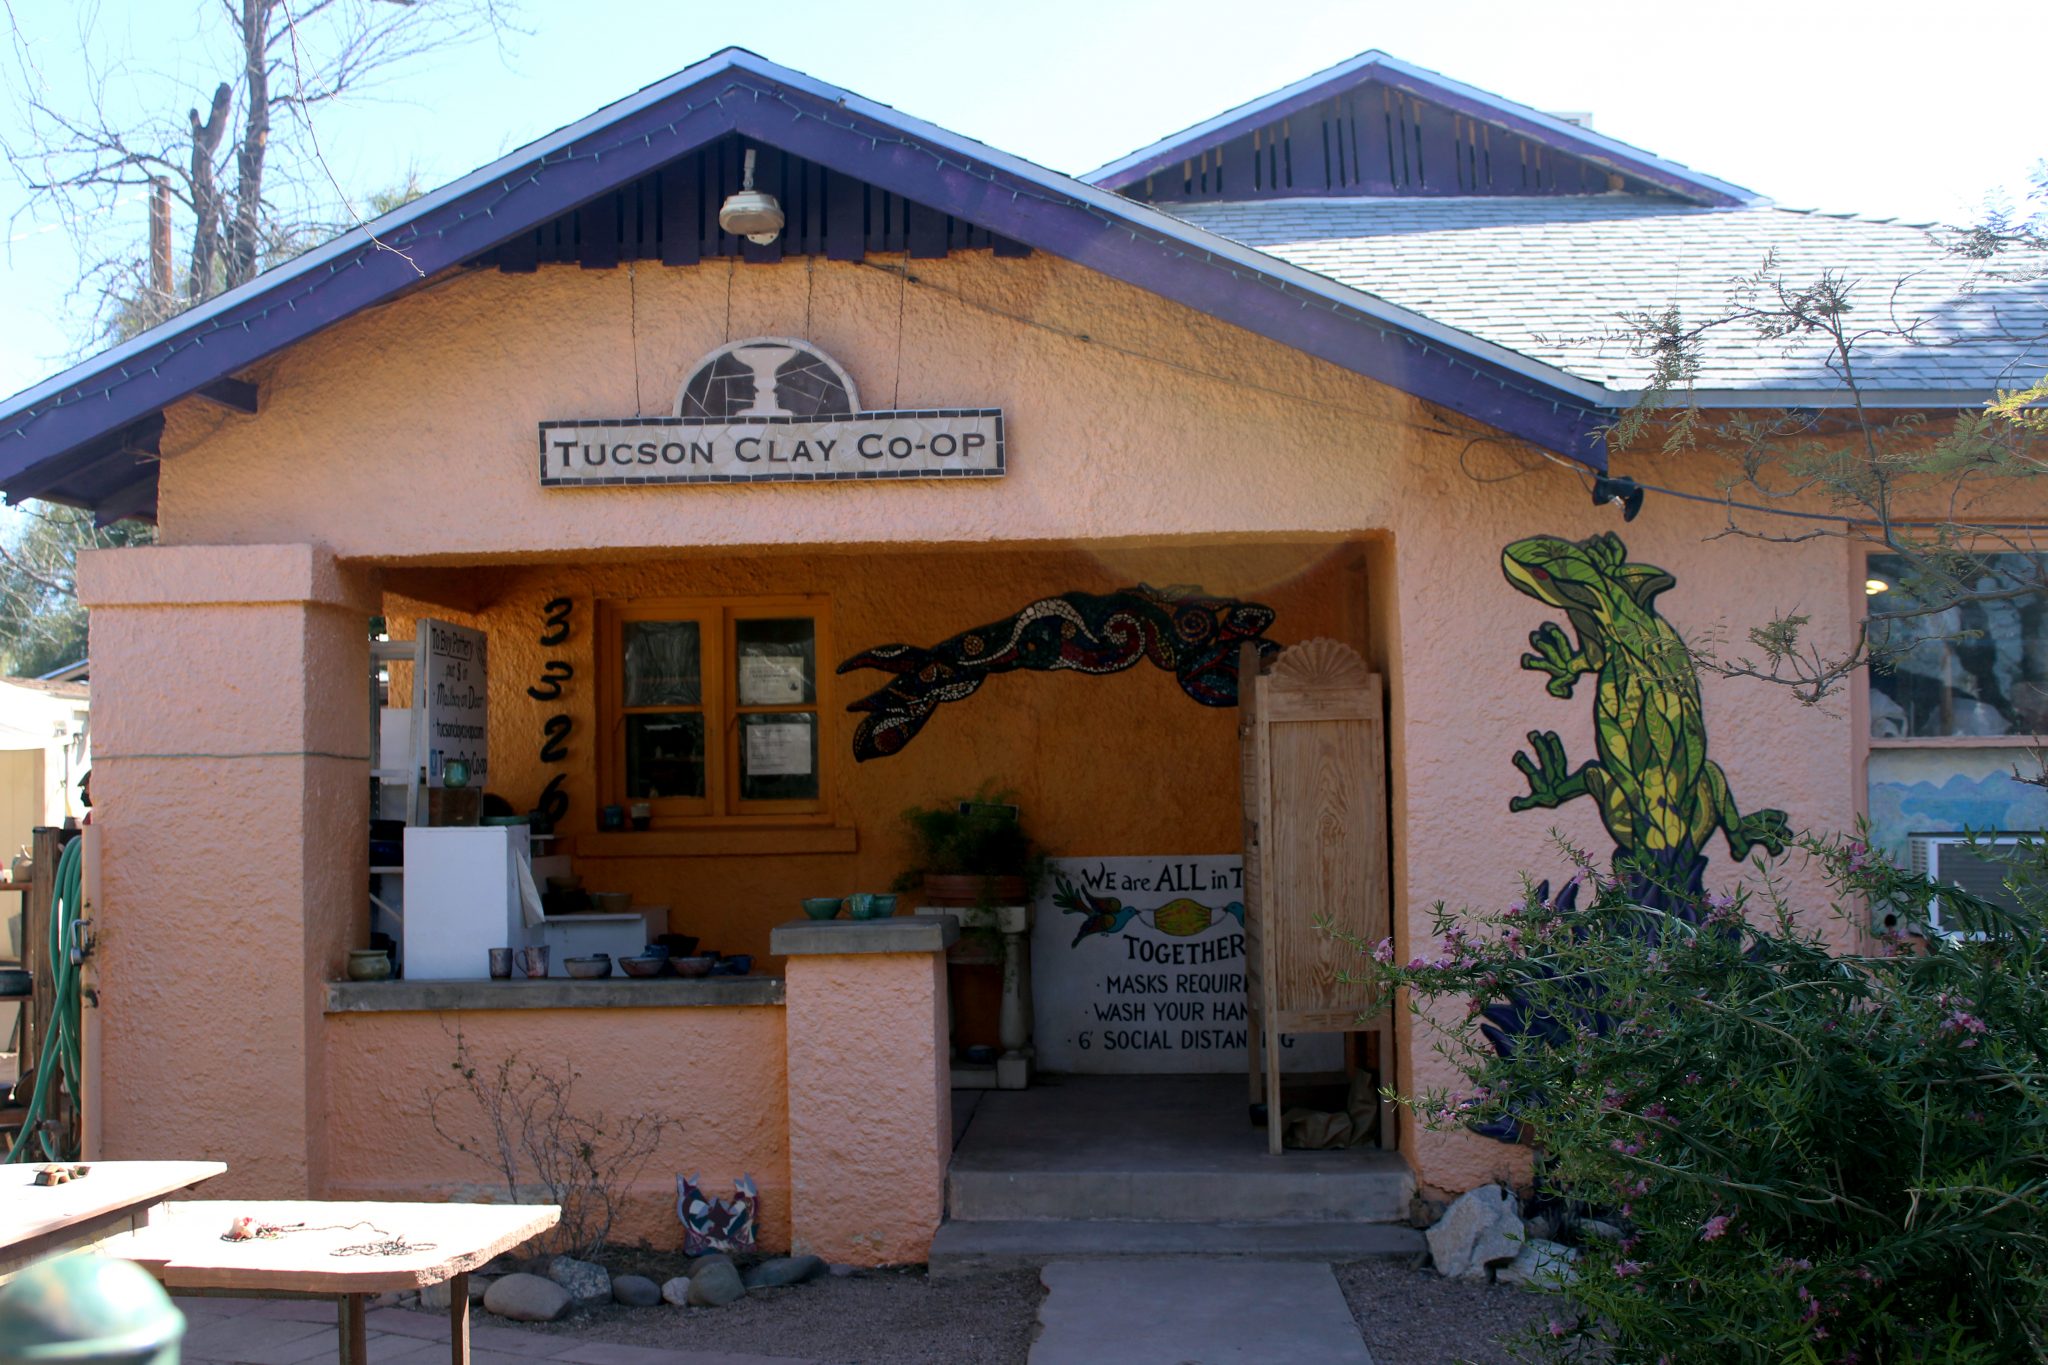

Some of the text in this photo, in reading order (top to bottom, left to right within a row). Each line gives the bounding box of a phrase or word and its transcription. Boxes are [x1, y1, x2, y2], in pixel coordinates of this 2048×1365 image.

[553, 432, 987, 468] TUCSON CLAY CO-OP
[527, 597, 573, 825] 3326
[1121, 875, 1151, 891] are
[1153, 863, 1207, 892] ALL
[1211, 870, 1228, 889] in
[1123, 933, 1246, 964] TOGETHER
[1106, 974, 1249, 994] MASKS REQUIR
[1094, 1002, 1248, 1021] WASH YOUR HAN
[1104, 1030, 1173, 1049] SOCIAL
